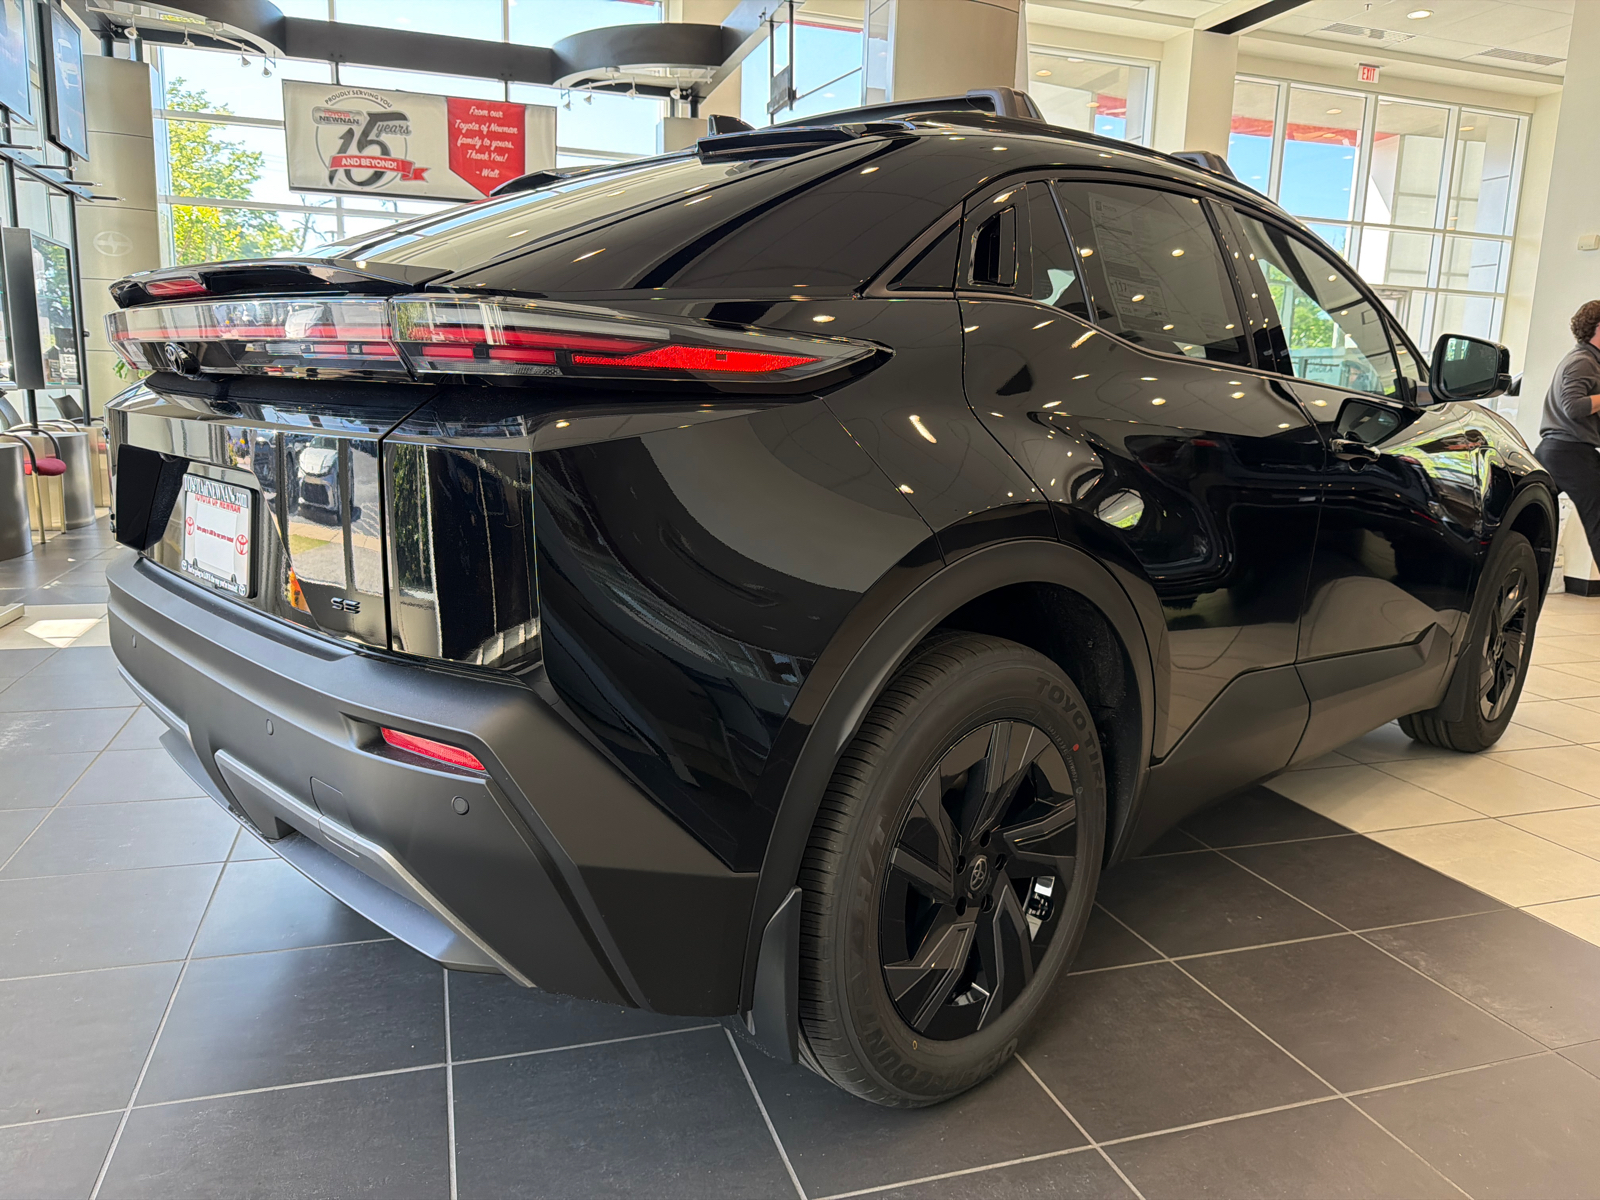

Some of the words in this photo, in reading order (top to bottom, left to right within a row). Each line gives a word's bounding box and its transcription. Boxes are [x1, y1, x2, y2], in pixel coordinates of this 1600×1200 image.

[1362, 66, 1376, 81] EXIT
[325, 90, 351, 105] PROUDLY
[351, 89, 379, 100] SERVING
[379, 97, 393, 109] YOU
[323, 110, 351, 118] TOYOTA
[469, 105, 489, 117] From
[489, 110, 503, 118] our
[319, 115, 360, 125] NEWNAN
[454, 119, 479, 134] Toyota
[480, 122, 489, 135] of
[489, 122, 518, 134] Newnan
[375, 123, 412, 139] years
[328, 112, 408, 187] 15
[457, 134, 482, 150] family
[482, 137, 491, 146] to
[490, 140, 515, 151] yours.
[466, 149, 489, 161] Thank
[490, 152, 508, 162] You!
[341, 157, 359, 166] AND
[360, 158, 397, 170] BEYOND!
[481, 168, 500, 178] Walt
[330, 596, 361, 615] SE
[1036, 676, 1088, 732] TOYO
